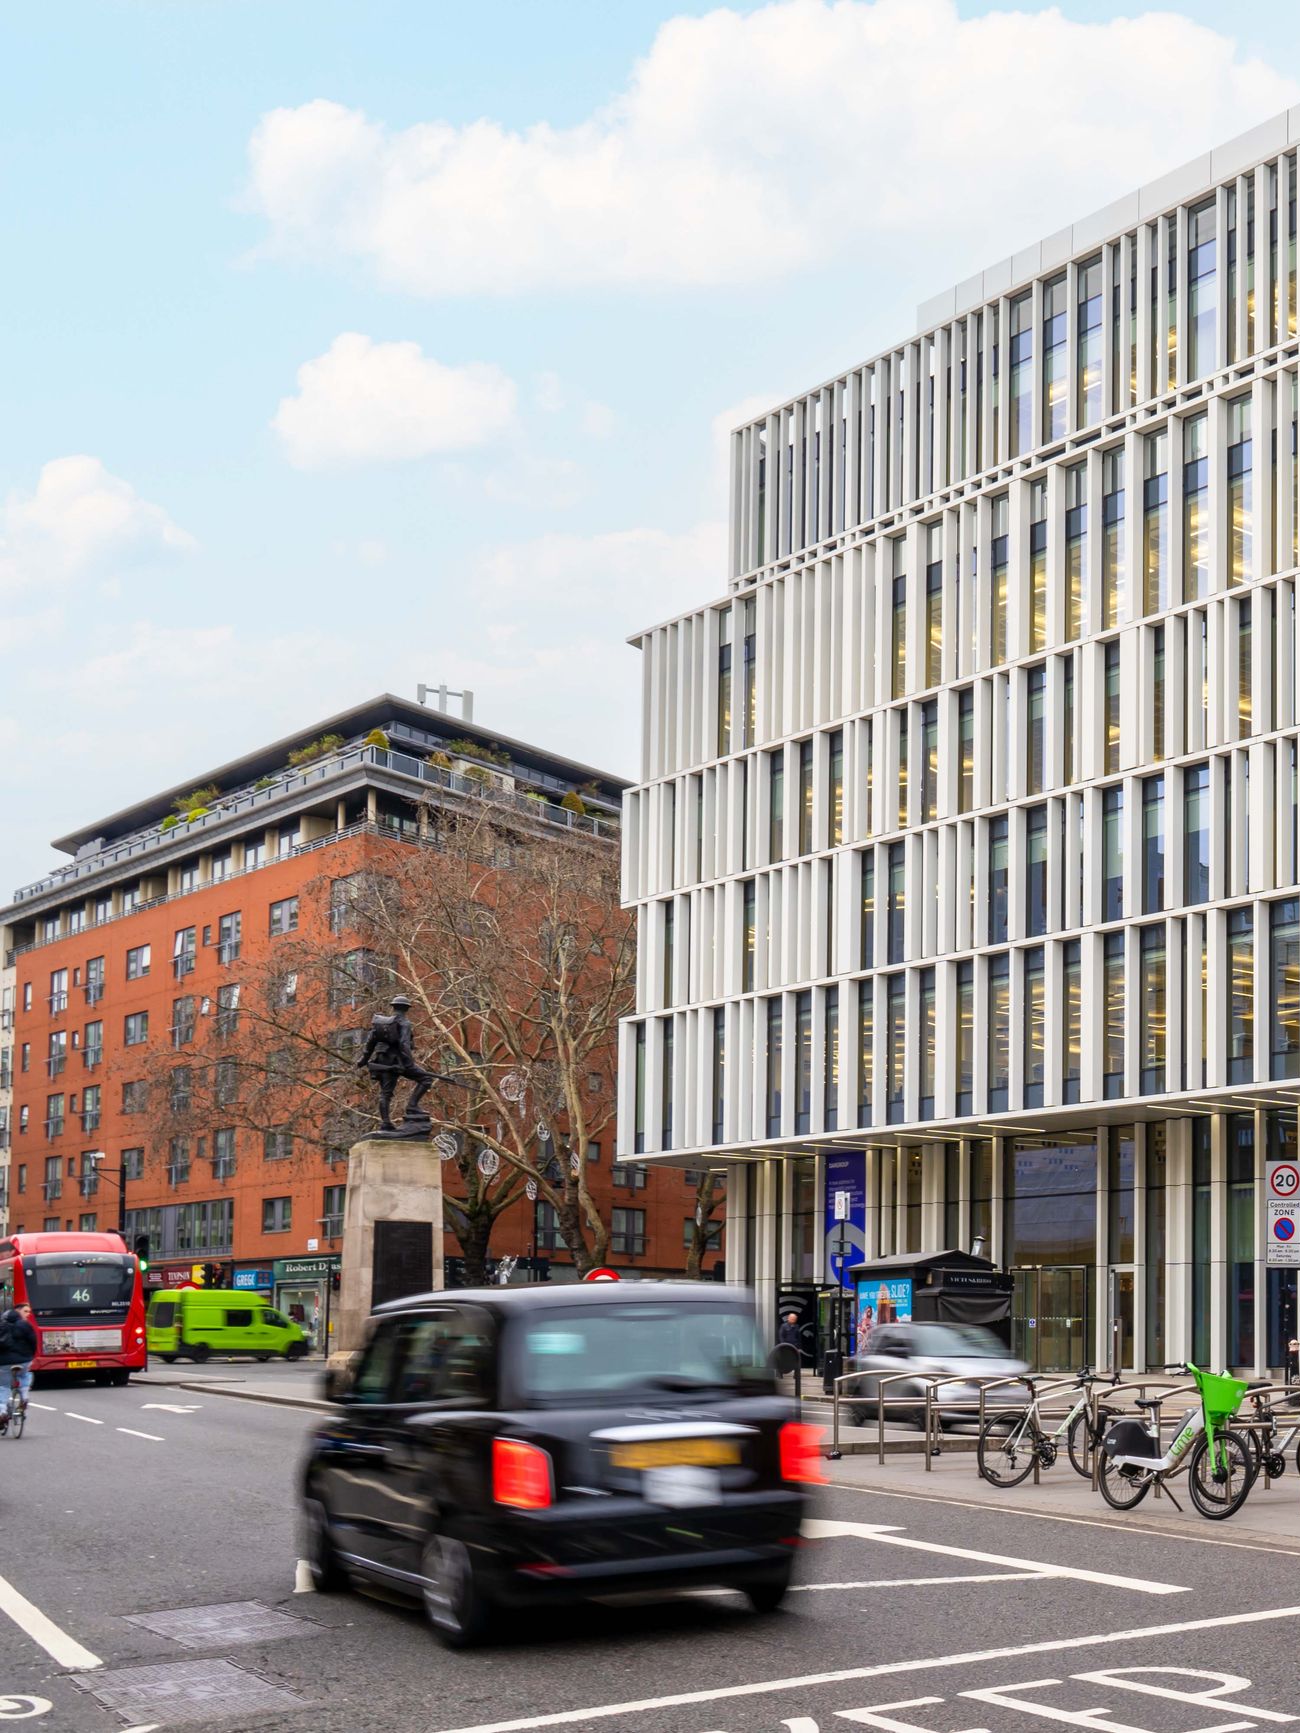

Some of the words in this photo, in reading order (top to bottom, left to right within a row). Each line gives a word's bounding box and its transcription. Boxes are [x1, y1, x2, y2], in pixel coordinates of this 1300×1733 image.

[1275, 1174, 1296, 1187] 20
[285, 1264, 317, 1273] Robert
[71, 1288, 90, 1302] 46
[890, 1283, 910, 1298] SLIDE?
